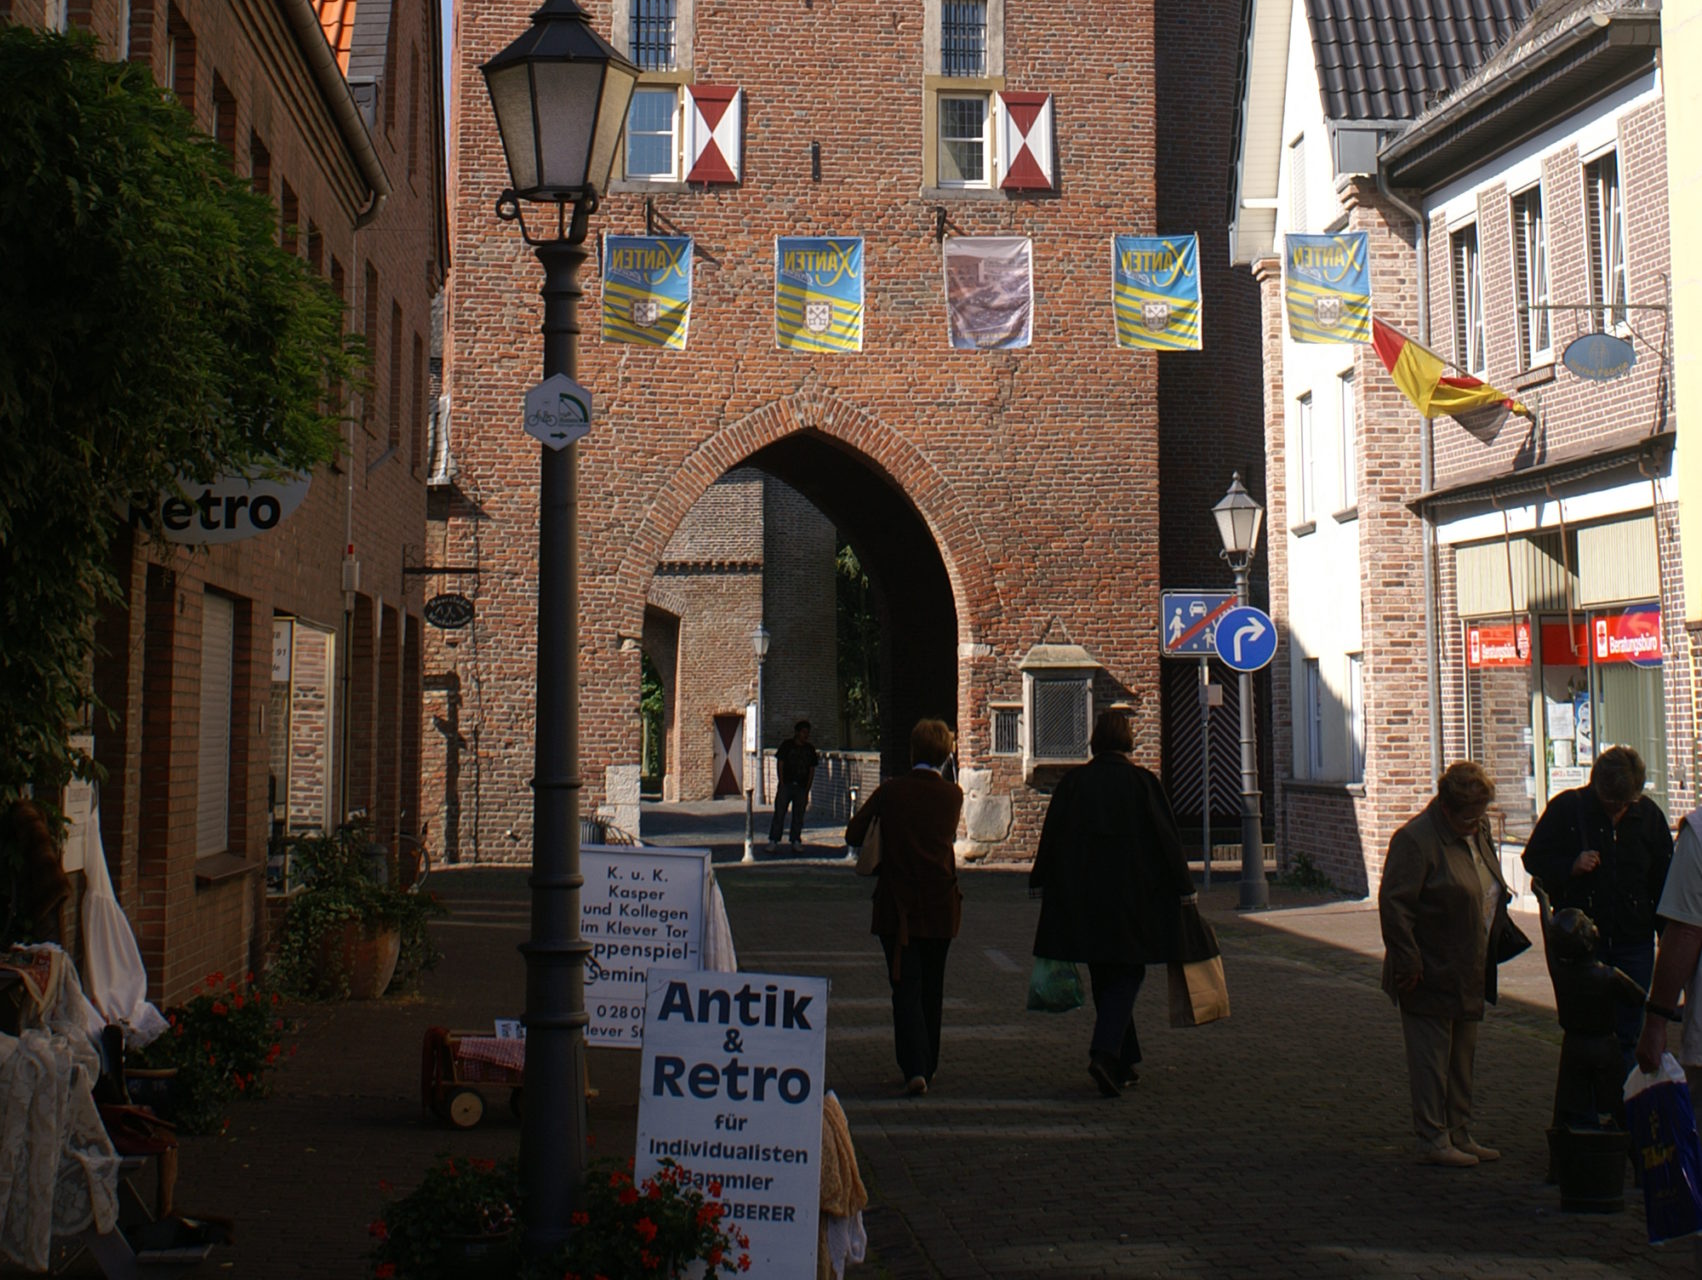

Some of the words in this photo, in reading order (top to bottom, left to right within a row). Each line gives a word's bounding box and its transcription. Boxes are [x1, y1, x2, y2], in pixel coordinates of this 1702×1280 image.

[607, 866, 623, 880] K.
[631, 870, 645, 881] u.
[653, 869, 668, 883] K.
[608, 885, 665, 902] Kasper
[583, 903, 612, 916] und
[619, 904, 689, 923] Kollegen
[581, 919, 599, 933] im
[606, 922, 658, 937] Klever
[666, 925, 689, 938] Tor
[593, 942, 698, 962] ppenspiel-
[589, 963, 647, 982] Semin
[657, 981, 813, 1030] Antik
[584, 1022, 624, 1037] lever
[723, 1028, 744, 1053] &
[652, 1055, 811, 1105] Retro
[714, 1114, 748, 1131] für
[649, 1138, 808, 1164] Individualisten
[707, 1197, 796, 1222] ÖBERER
